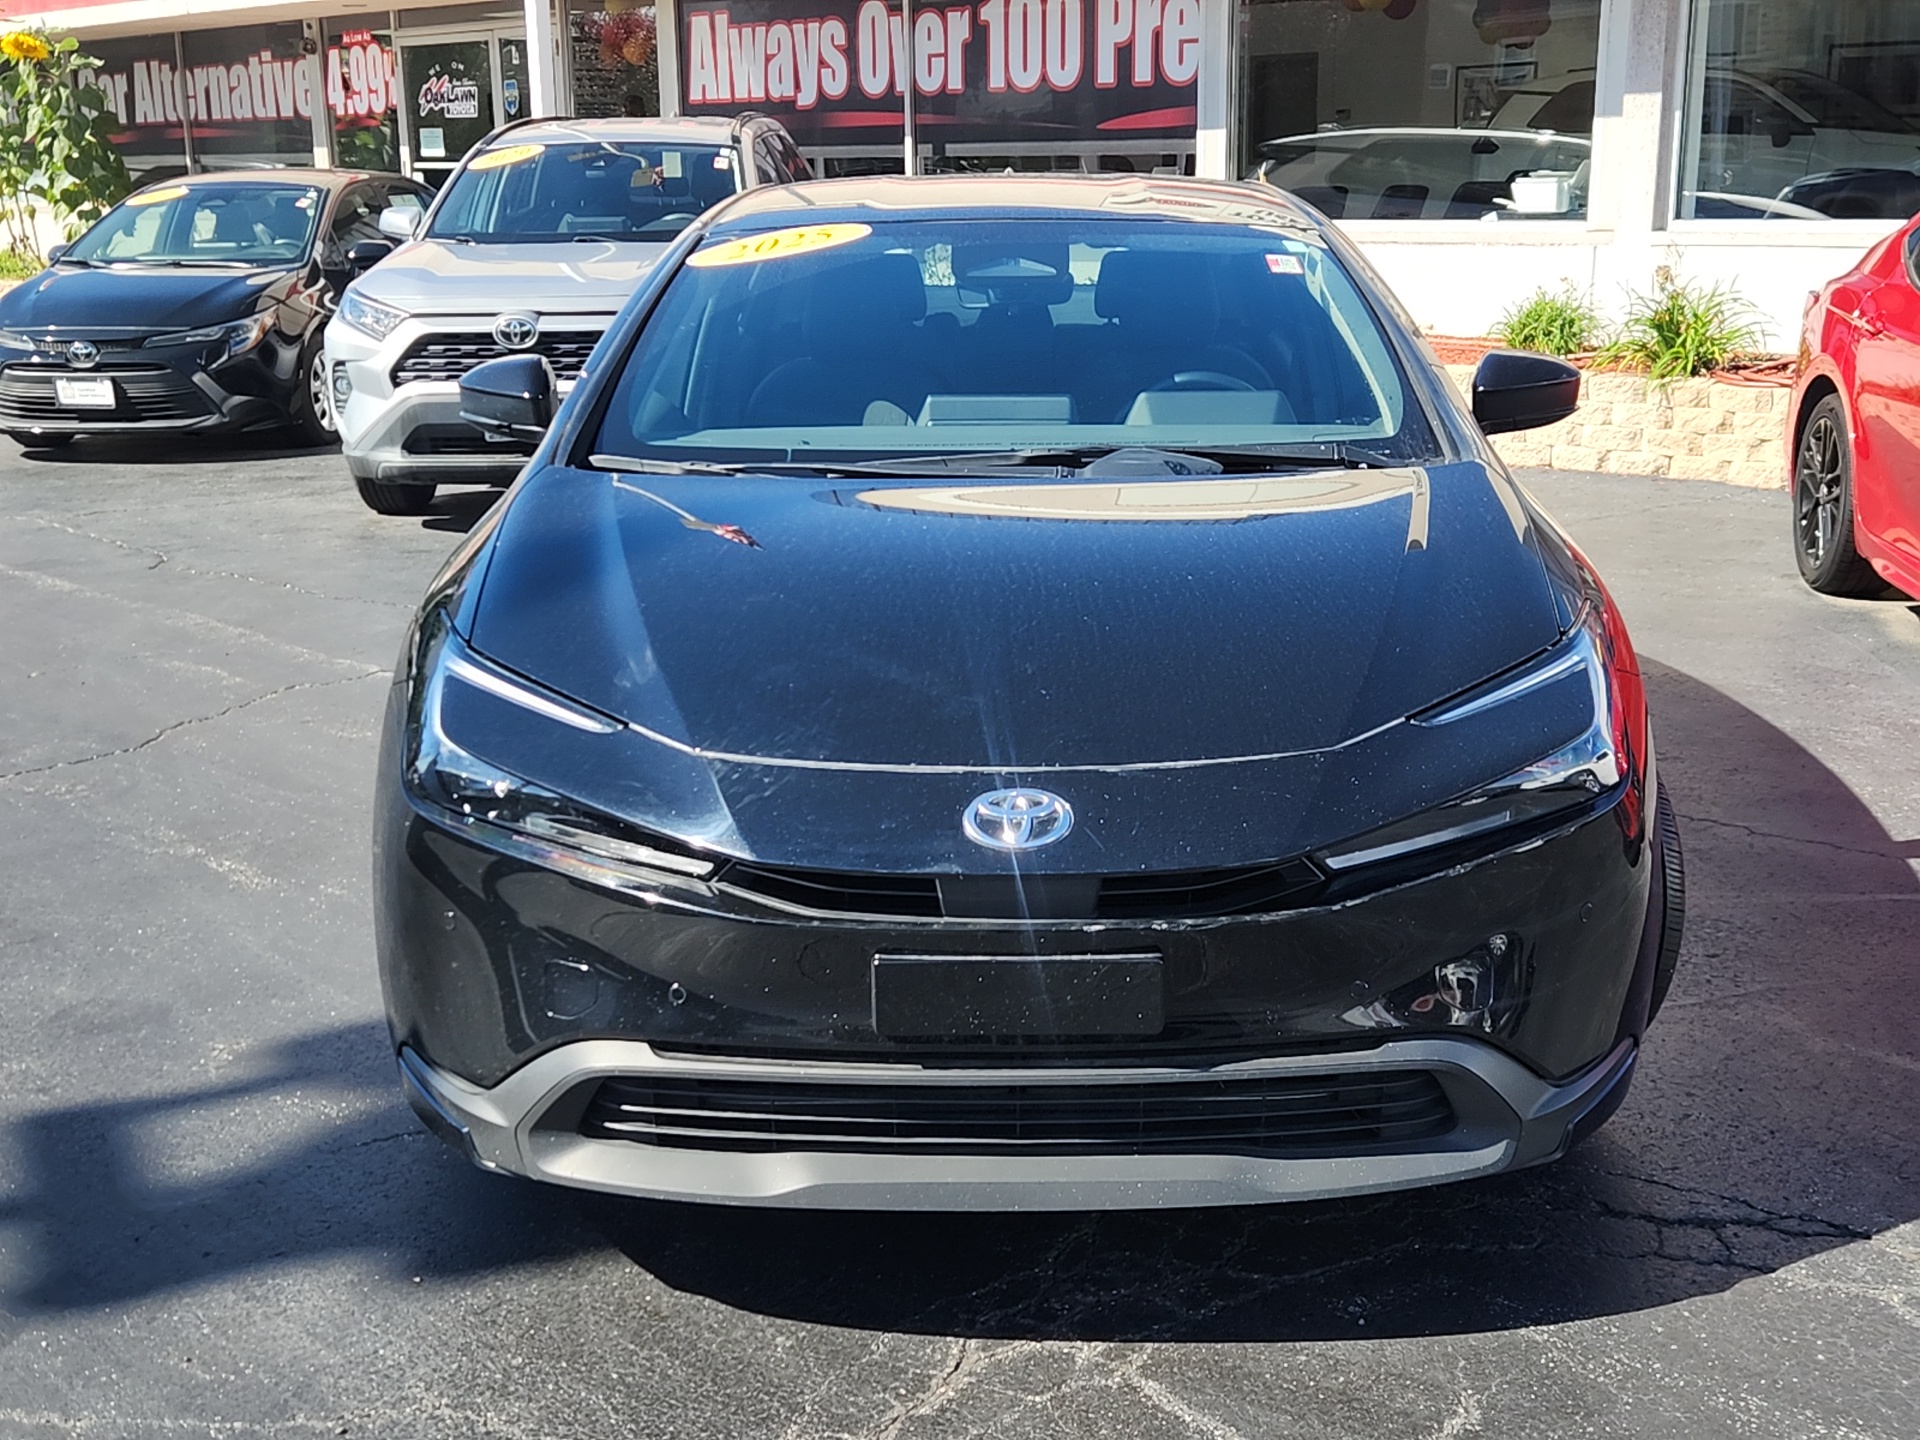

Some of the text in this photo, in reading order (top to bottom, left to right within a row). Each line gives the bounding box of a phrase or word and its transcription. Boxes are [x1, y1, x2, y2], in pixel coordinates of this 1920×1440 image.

[134, 49, 313, 126] Alternative
[690, 0, 1199, 108] Always Over 100 Pre
[726, 227, 836, 260] 2025
